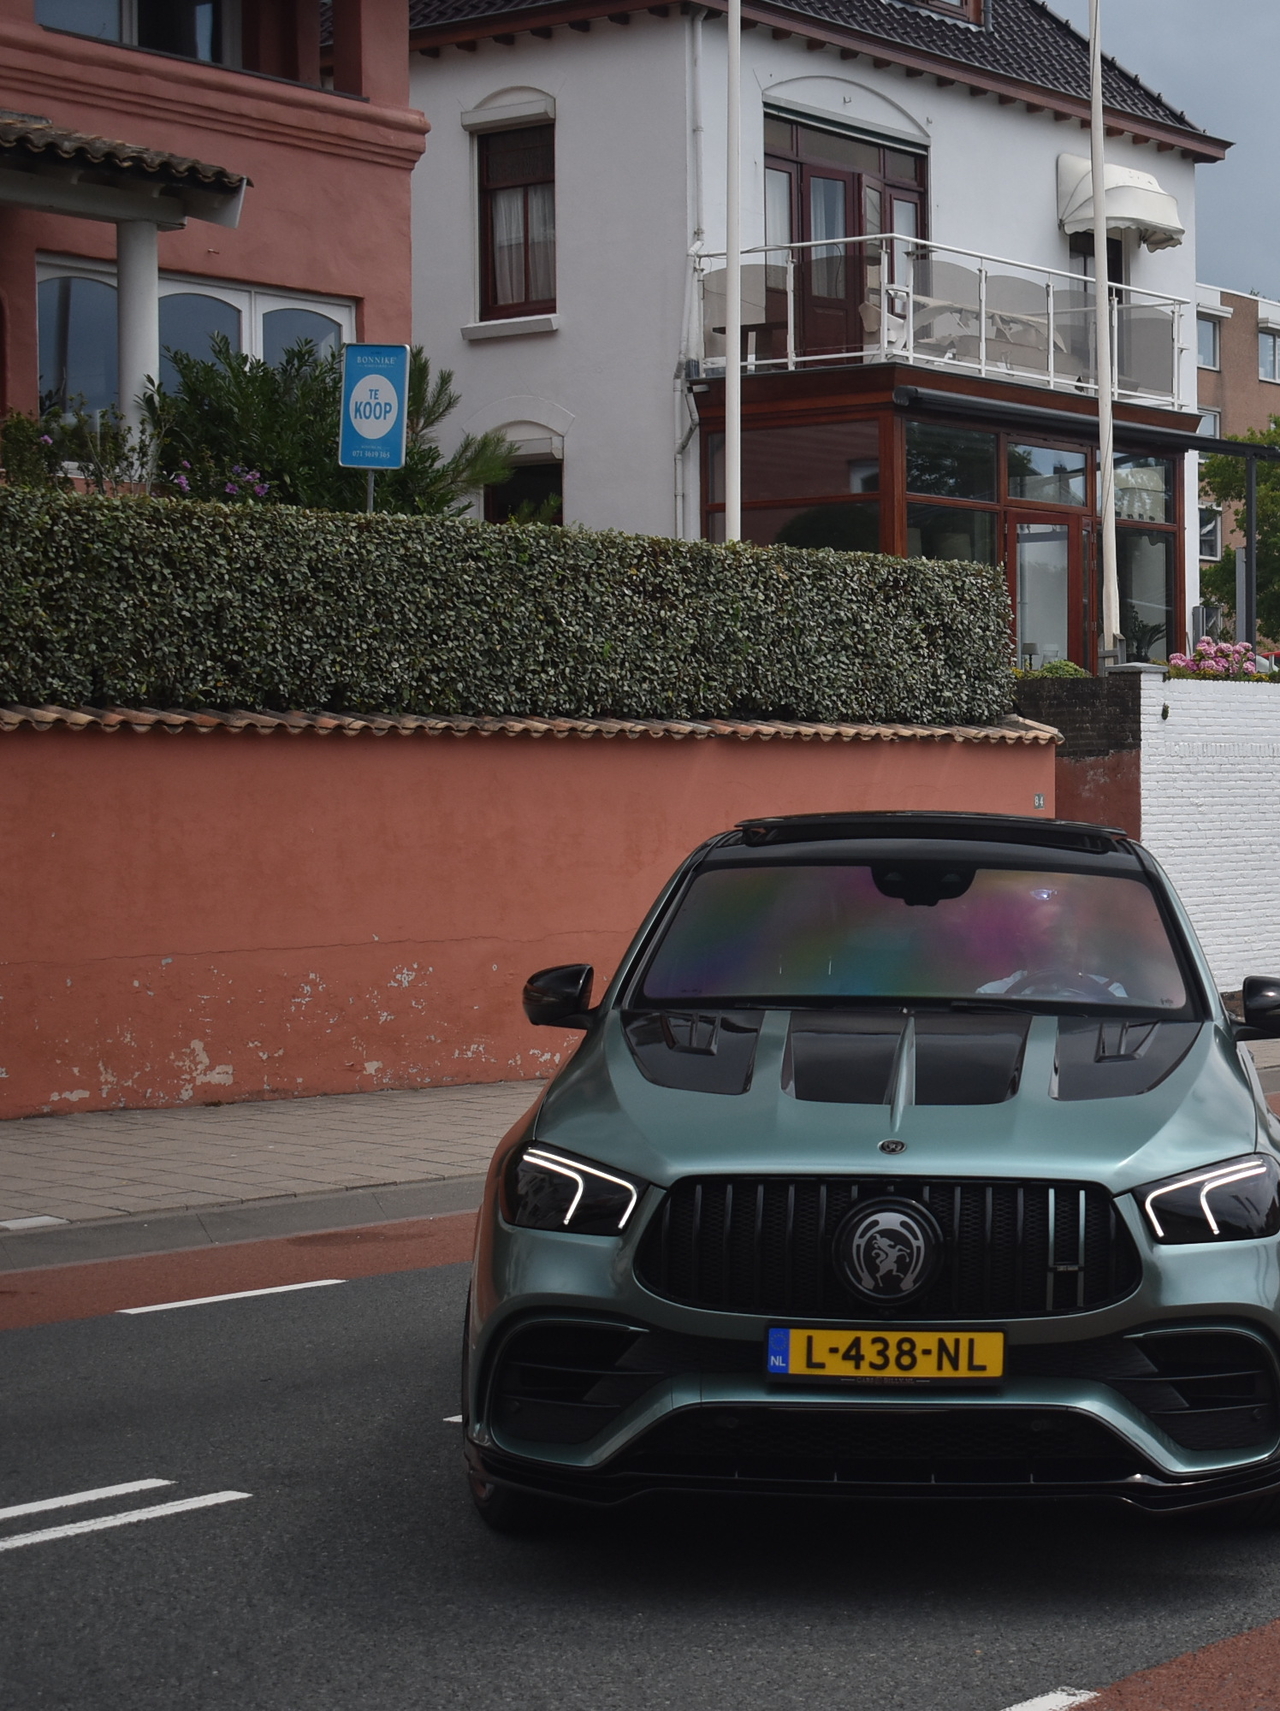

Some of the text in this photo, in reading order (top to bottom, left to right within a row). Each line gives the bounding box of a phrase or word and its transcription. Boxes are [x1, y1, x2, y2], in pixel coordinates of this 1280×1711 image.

[357, 356, 395, 364] BONNIKE
[369, 389, 379, 400] TE
[354, 401, 393, 420] KOOP
[352, 450, 363, 458] 071
[770, 1335, 988, 1372] NL L-438-NL
